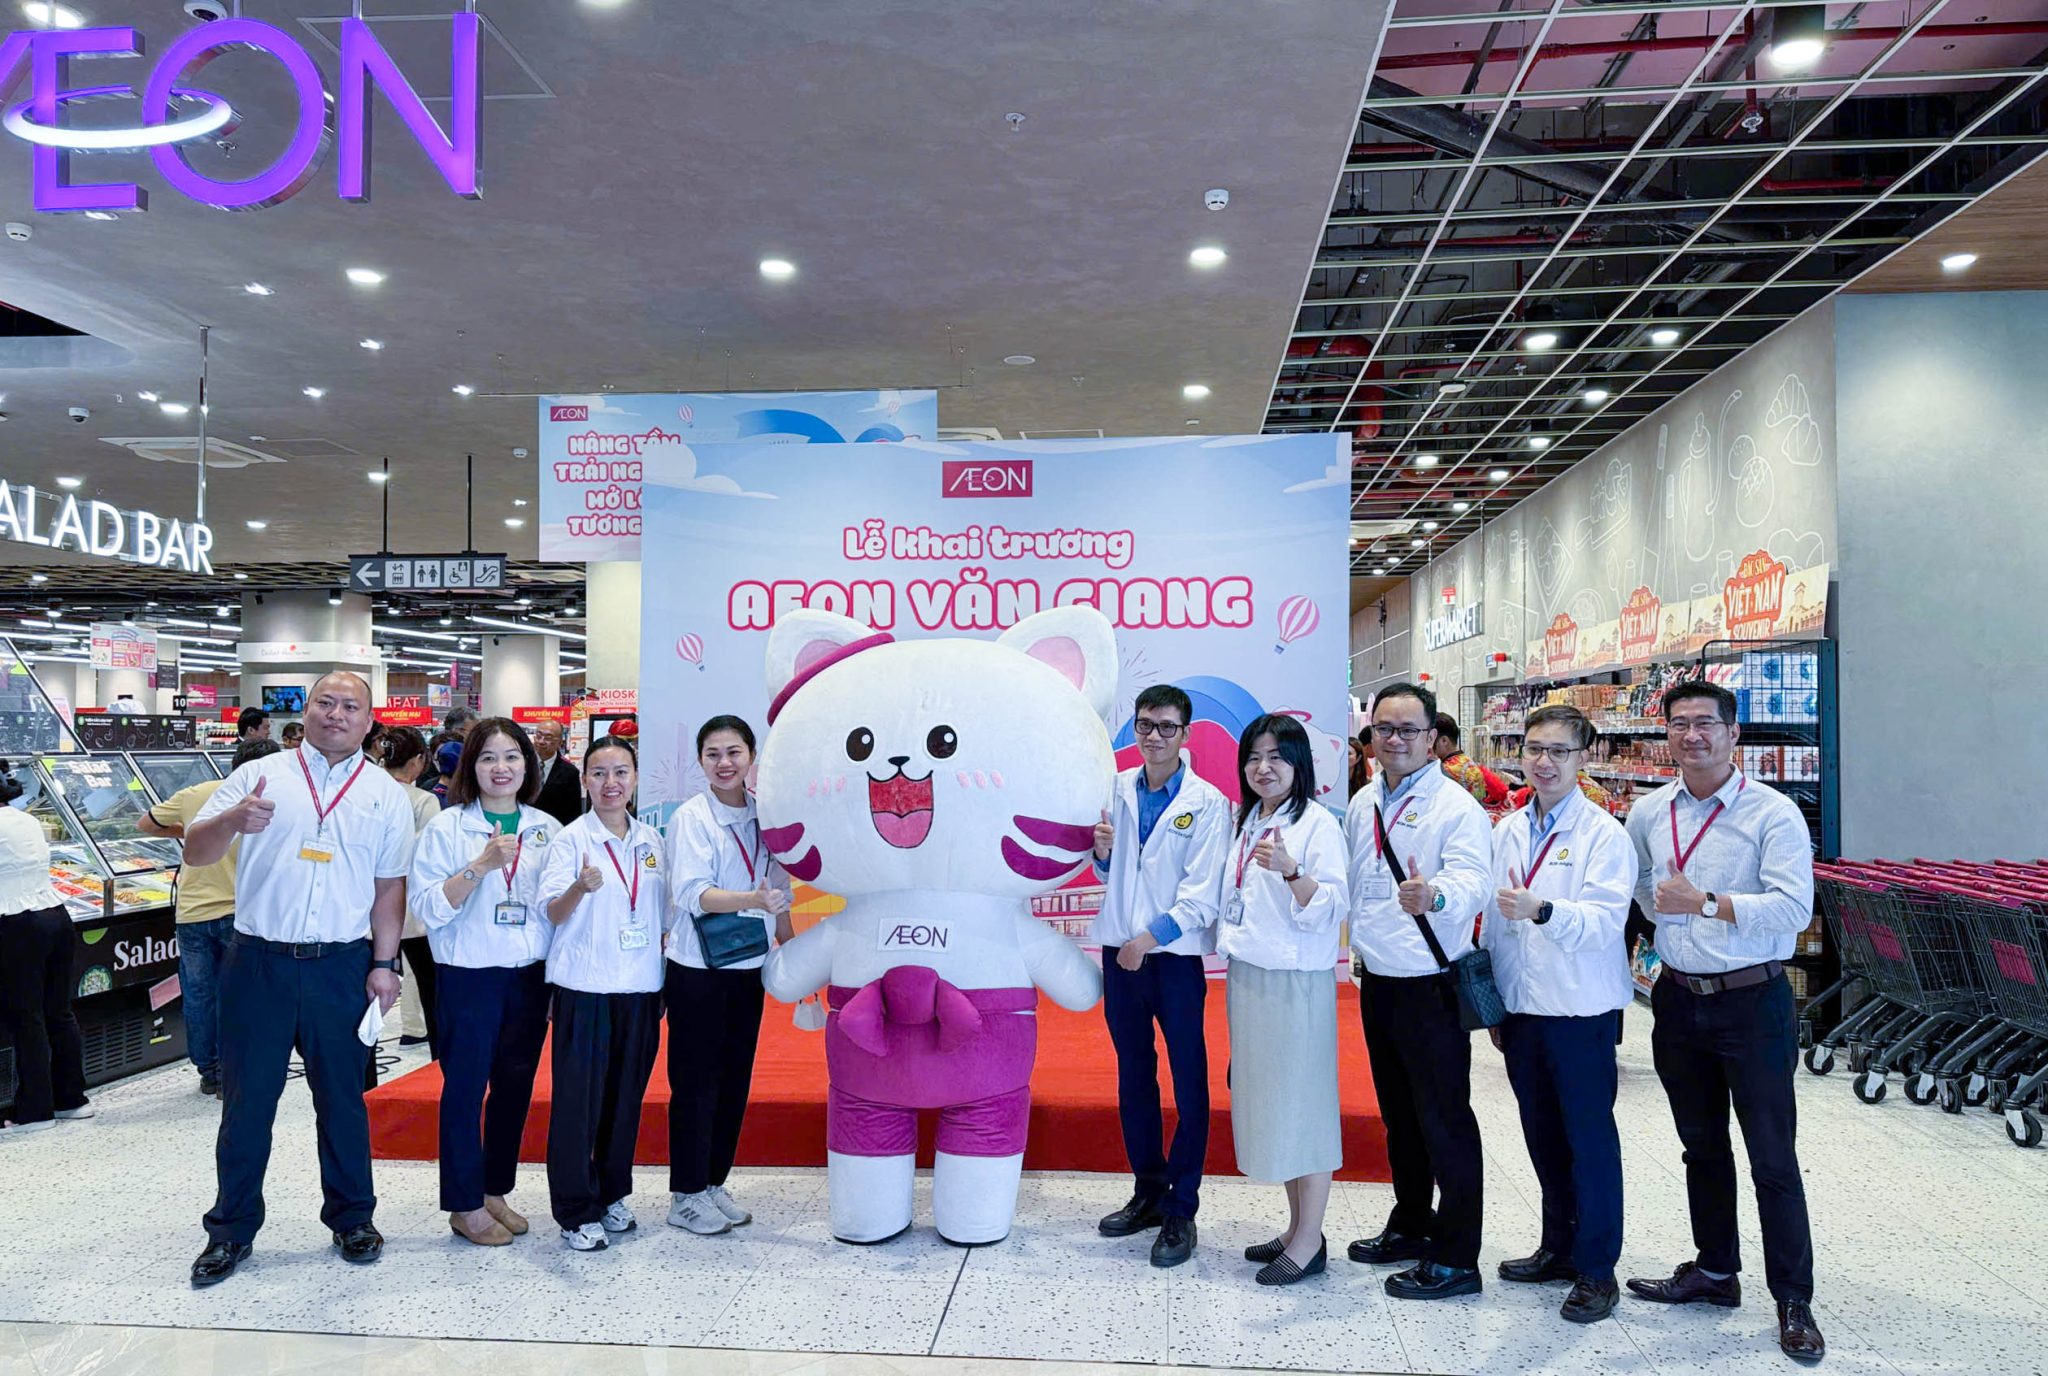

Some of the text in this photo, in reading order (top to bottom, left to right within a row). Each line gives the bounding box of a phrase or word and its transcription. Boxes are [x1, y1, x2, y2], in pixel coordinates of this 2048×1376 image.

[568, 431, 630, 455] NÂNG
[554, 456, 608, 482] TRẢI
[586, 484, 642, 510] MỞ L
[137, 511, 214, 575] BAR
[844, 519, 1134, 569] Lễ khai trương
[906, 567, 1040, 630] VĂN
[1753, 570, 1783, 614] NAM
[1424, 602, 1478, 651] SUPERMARKET
[174, 698, 186, 707] 10
[601, 690, 636, 699] KIOSK
[113, 931, 180, 971] Salad
